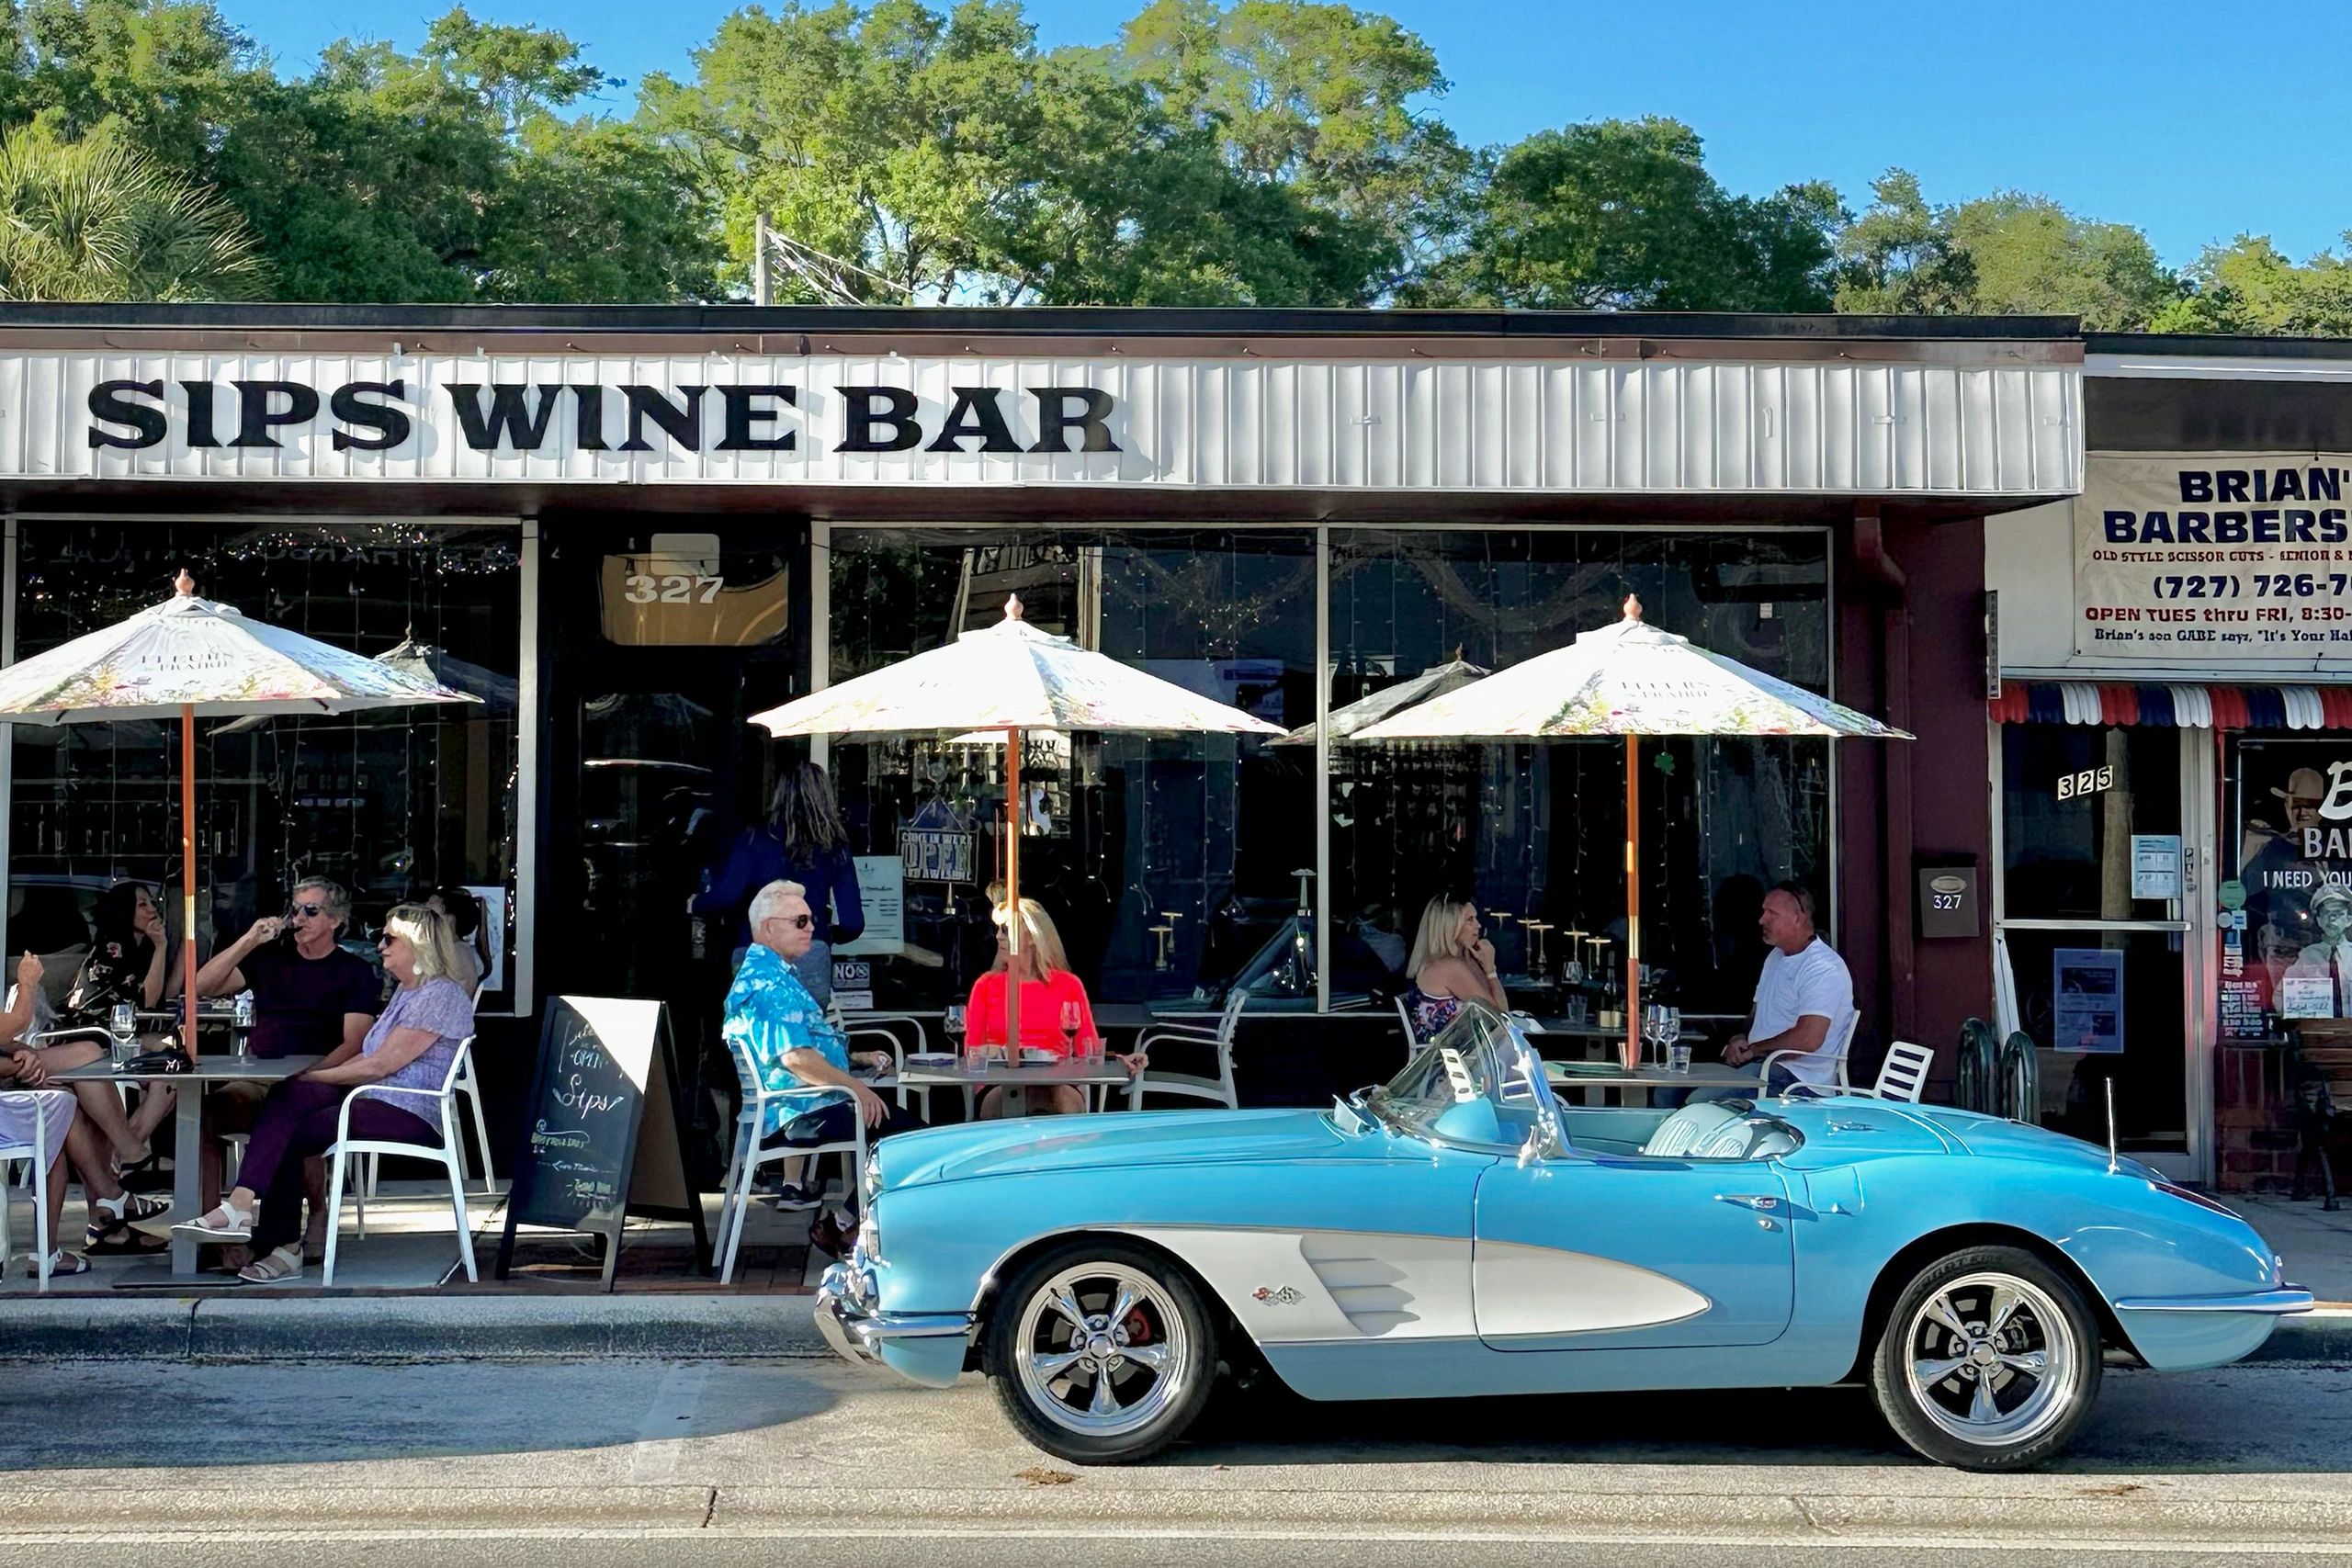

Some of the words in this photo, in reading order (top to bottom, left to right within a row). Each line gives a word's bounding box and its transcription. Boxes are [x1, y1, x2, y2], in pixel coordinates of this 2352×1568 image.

[88, 378, 411, 452] SIPS
[440, 382, 797, 453] WINE
[832, 386, 1125, 454] BAR
[2092, 550, 2118, 561] OLD
[2121, 551, 2164, 562] STYLE
[2167, 551, 2225, 562] SCISSOR
[2229, 550, 2265, 562] CUTS
[2335, 549, 2344, 561] &
[625, 575, 724, 604] 327
[2154, 574, 2240, 598] (727)
[2254, 573, 2352, 597] 726-7
[2086, 607, 2141, 622] OPEN
[2146, 608, 2197, 622] TUES
[2203, 608, 2249, 622] thru
[2256, 607, 2294, 624] FRI,
[2094, 627, 2144, 641] Brian's
[2148, 632, 2173, 641] son
[2177, 629, 2217, 641] GABE
[2290, 629, 2325, 641] Your
[2059, 767, 2111, 797] 325
[901, 843, 972, 870] OPEN
[2263, 871, 2268, 887] I
[2272, 871, 2313, 889] NEED
[1933, 894, 1962, 909] 327
[834, 964, 855, 979] NO
